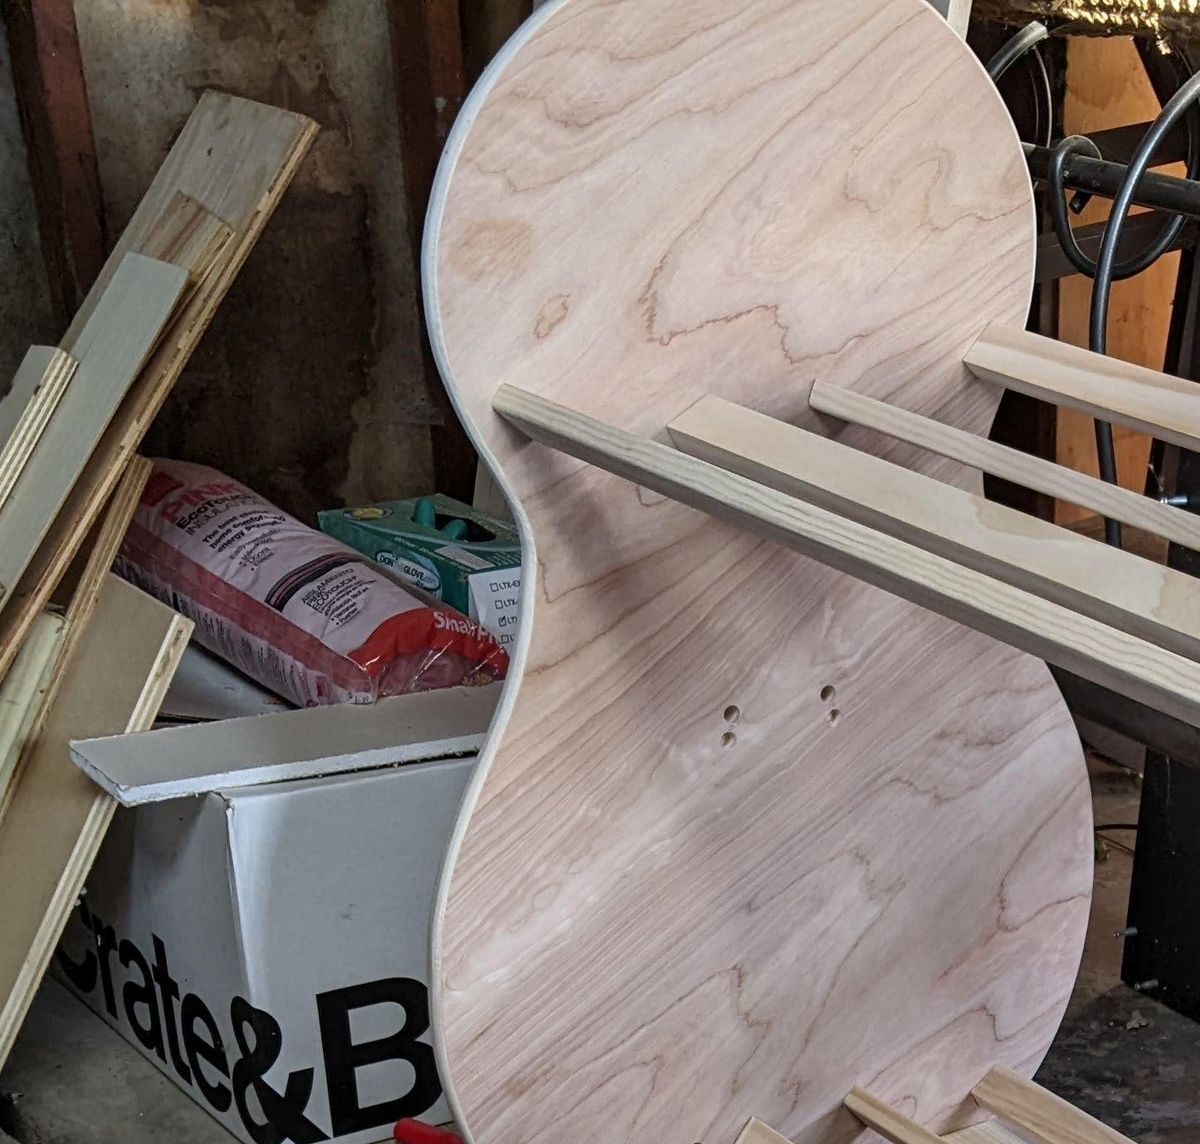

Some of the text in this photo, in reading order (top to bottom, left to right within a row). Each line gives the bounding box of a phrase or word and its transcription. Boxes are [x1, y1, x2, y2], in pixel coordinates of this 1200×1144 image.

[202, 529, 219, 543] The
[210, 528, 232, 549] home
[217, 530, 244, 552] energy
